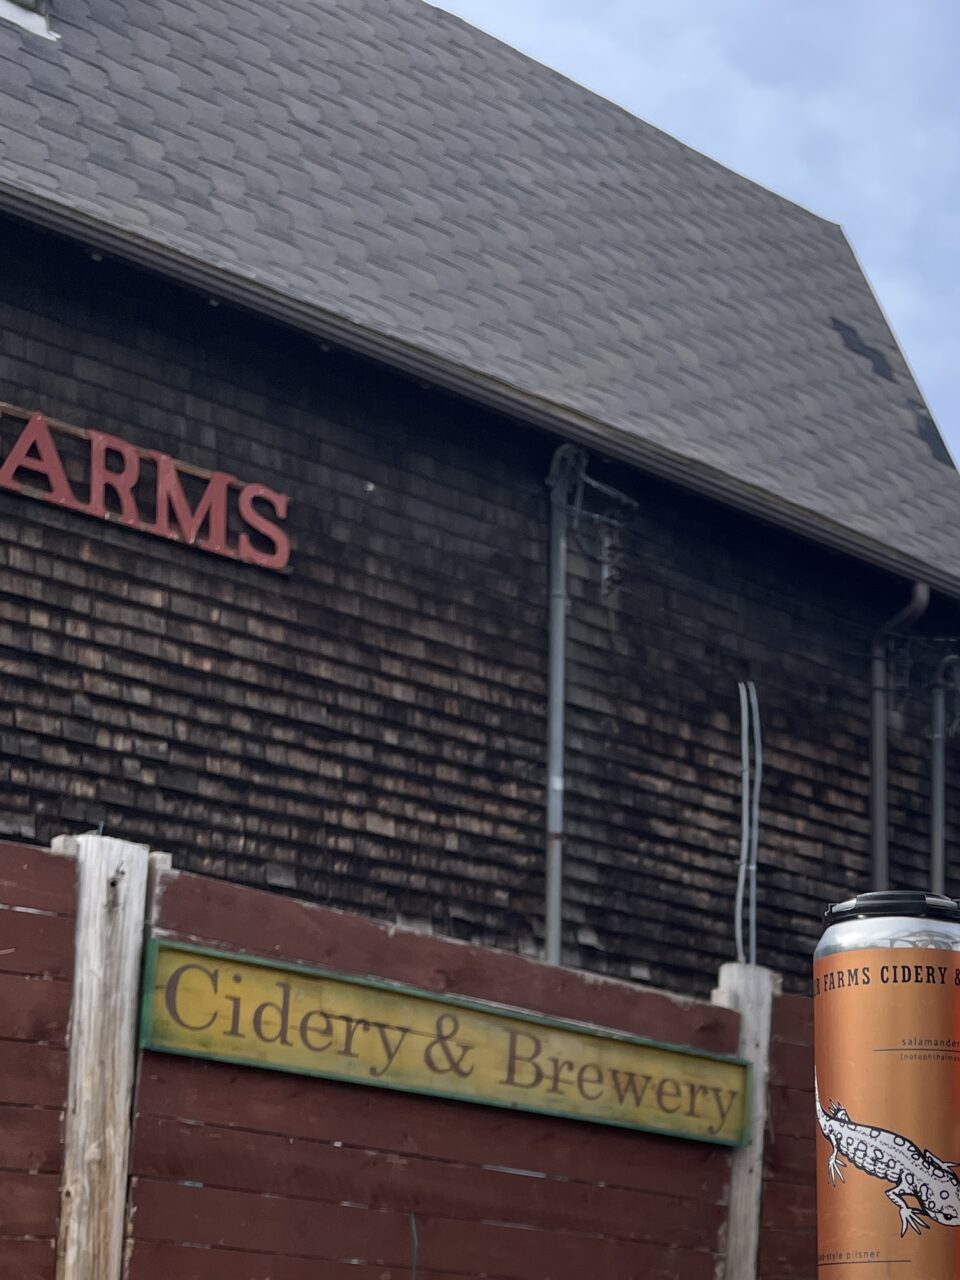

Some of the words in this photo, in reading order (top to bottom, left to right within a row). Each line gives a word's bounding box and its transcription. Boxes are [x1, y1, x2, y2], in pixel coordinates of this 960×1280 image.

[824, 967, 870, 992] FARMS
[880, 965, 948, 984] CIDERY
[164, 963, 411, 1077] Cidery
[423, 1013, 475, 1078] &
[499, 1028, 739, 1136] Brewery
[902, 1037, 960, 1048] salamander
[846, 1250, 880, 1260] pilsner
